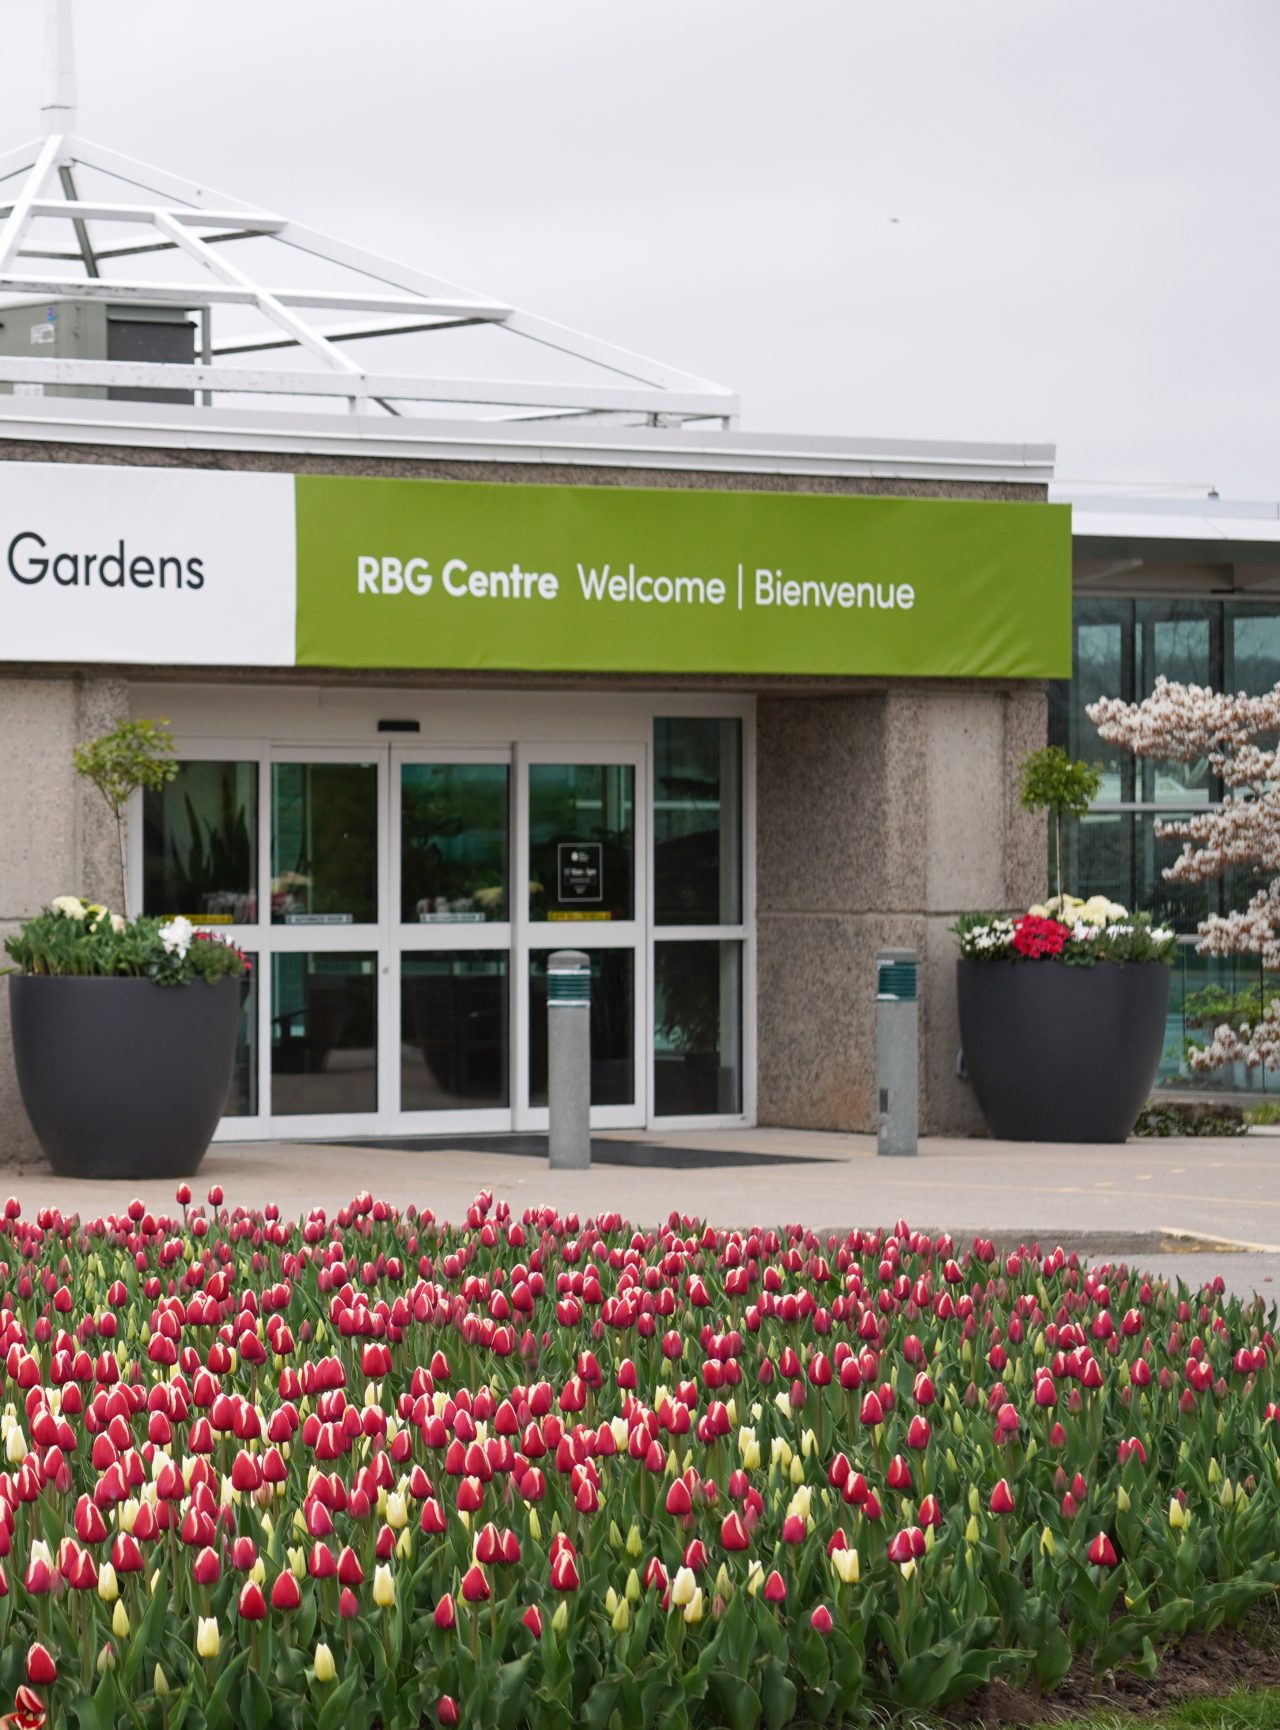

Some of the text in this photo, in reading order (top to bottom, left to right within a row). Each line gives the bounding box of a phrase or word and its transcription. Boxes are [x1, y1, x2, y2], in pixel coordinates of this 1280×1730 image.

[7, 531, 205, 590] Gardens
[357, 555, 915, 609] RBG Centre Welcome Bienvenue
